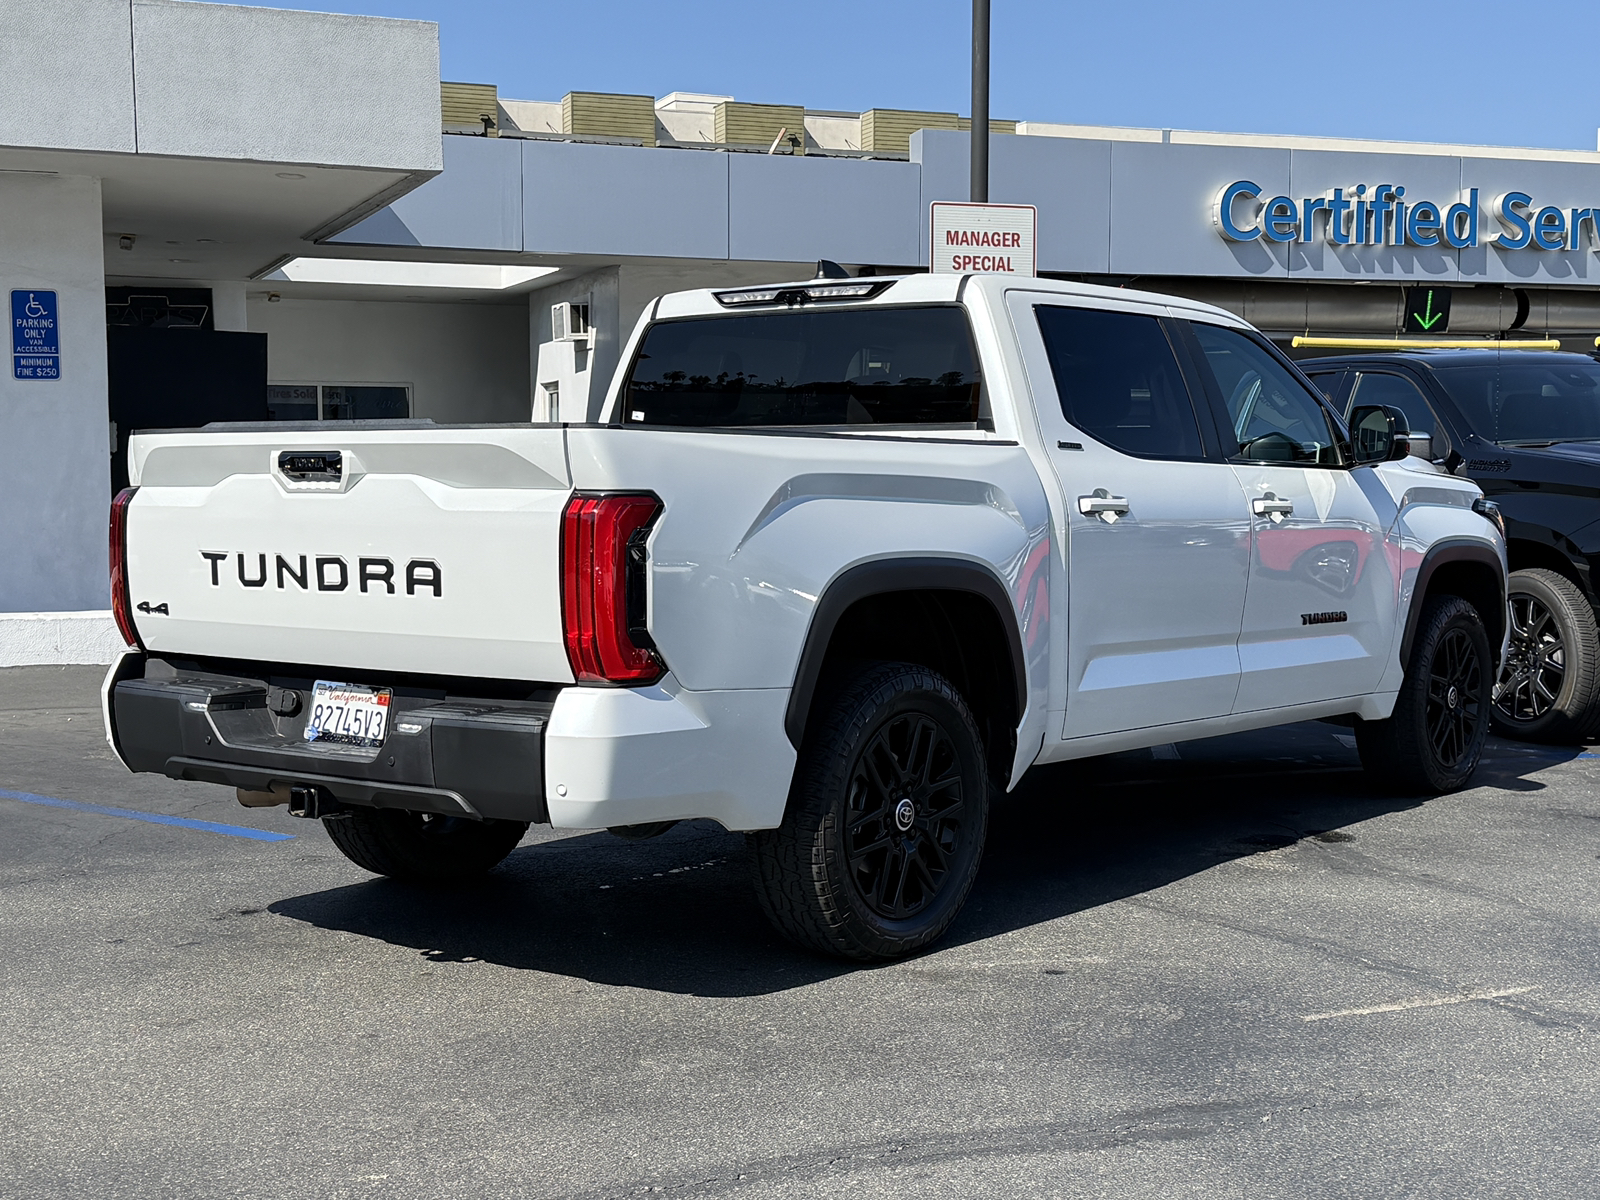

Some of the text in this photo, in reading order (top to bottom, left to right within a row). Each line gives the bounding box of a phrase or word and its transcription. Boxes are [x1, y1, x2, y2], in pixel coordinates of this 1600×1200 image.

[1217, 179, 1480, 249] Certified
[945, 230, 1021, 248] MANAGER
[952, 254, 1015, 272] SPECIAL
[16, 318, 54, 328] PARKING
[24, 329, 46, 338] ONLY
[20, 358, 53, 367] MINIMUM
[17, 367, 57, 377] FINE $250
[293, 389, 316, 399] Sold
[199, 550, 443, 598] TUNDRA
[1300, 610, 1348, 626] TUNDRA
[327, 686, 378, 706] California
[312, 703, 384, 739] 82745V3
